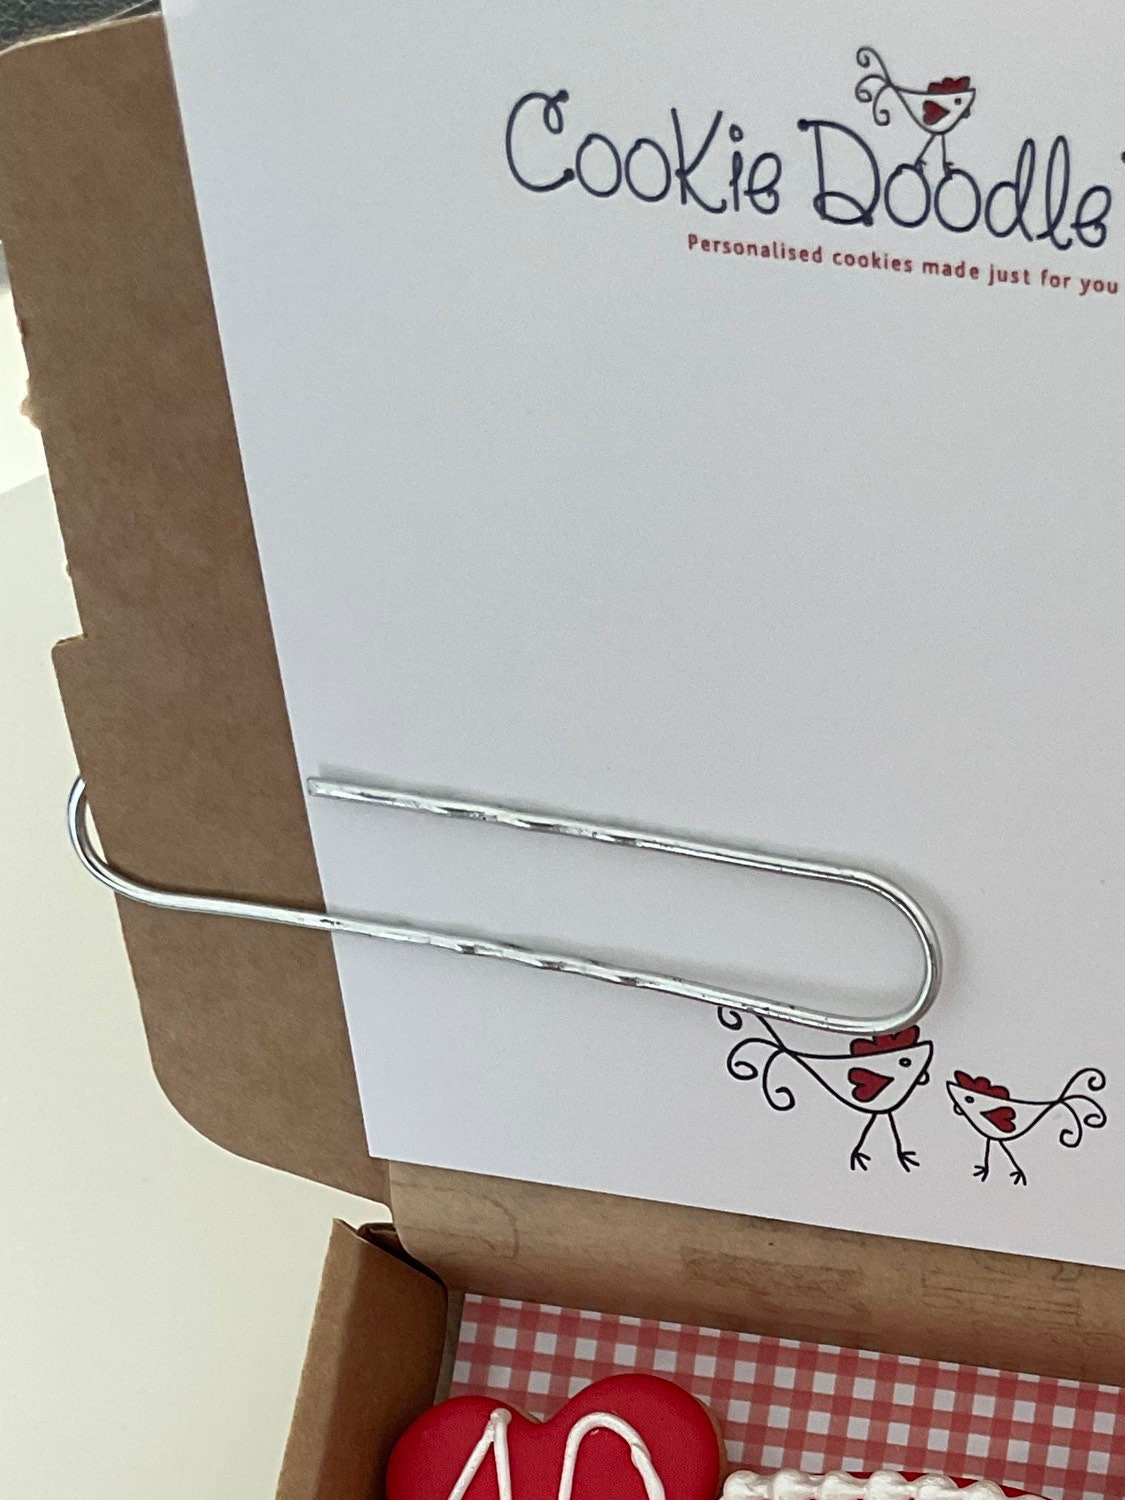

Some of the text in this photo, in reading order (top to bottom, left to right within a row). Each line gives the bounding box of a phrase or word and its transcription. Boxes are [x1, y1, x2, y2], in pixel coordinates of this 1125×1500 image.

[797, 119, 1113, 252] Doodle
[687, 233, 1120, 297] Personalised cookies made just for you
